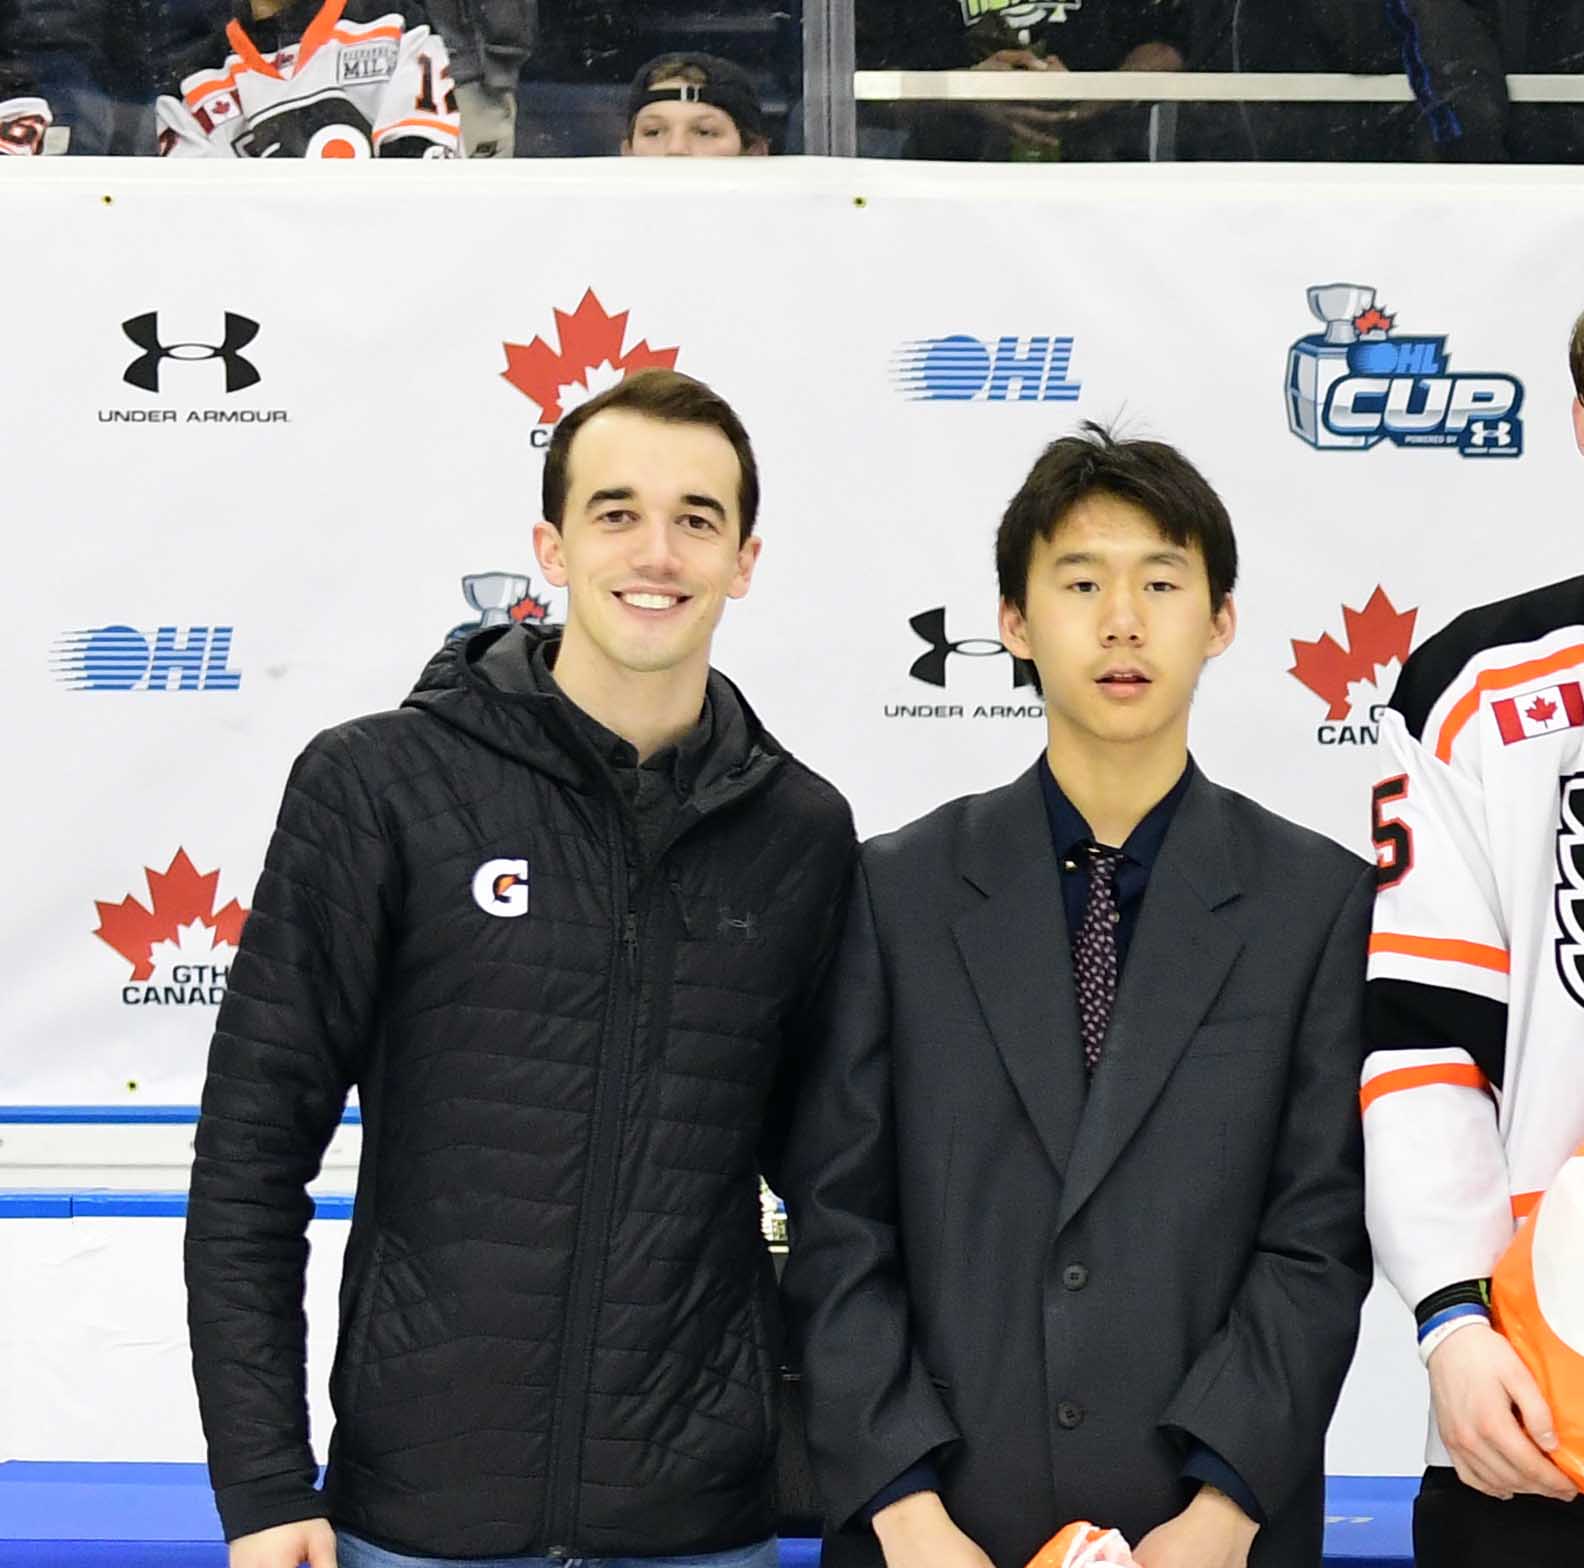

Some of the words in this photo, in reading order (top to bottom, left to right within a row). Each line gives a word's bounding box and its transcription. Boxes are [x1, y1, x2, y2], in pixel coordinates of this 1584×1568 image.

[890, 336, 1082, 402] OHL
[1327, 376, 1517, 434] CUP
[98, 410, 177, 423] UNDER
[186, 410, 290, 423] ARMOUR
[48, 625, 243, 691] OHL
[884, 705, 964, 718] UNDER
[972, 705, 1044, 718] ARMO
[1317, 726, 1378, 745] CAN
[172, 965, 230, 984] GTH
[122, 986, 225, 1005] CANAD
